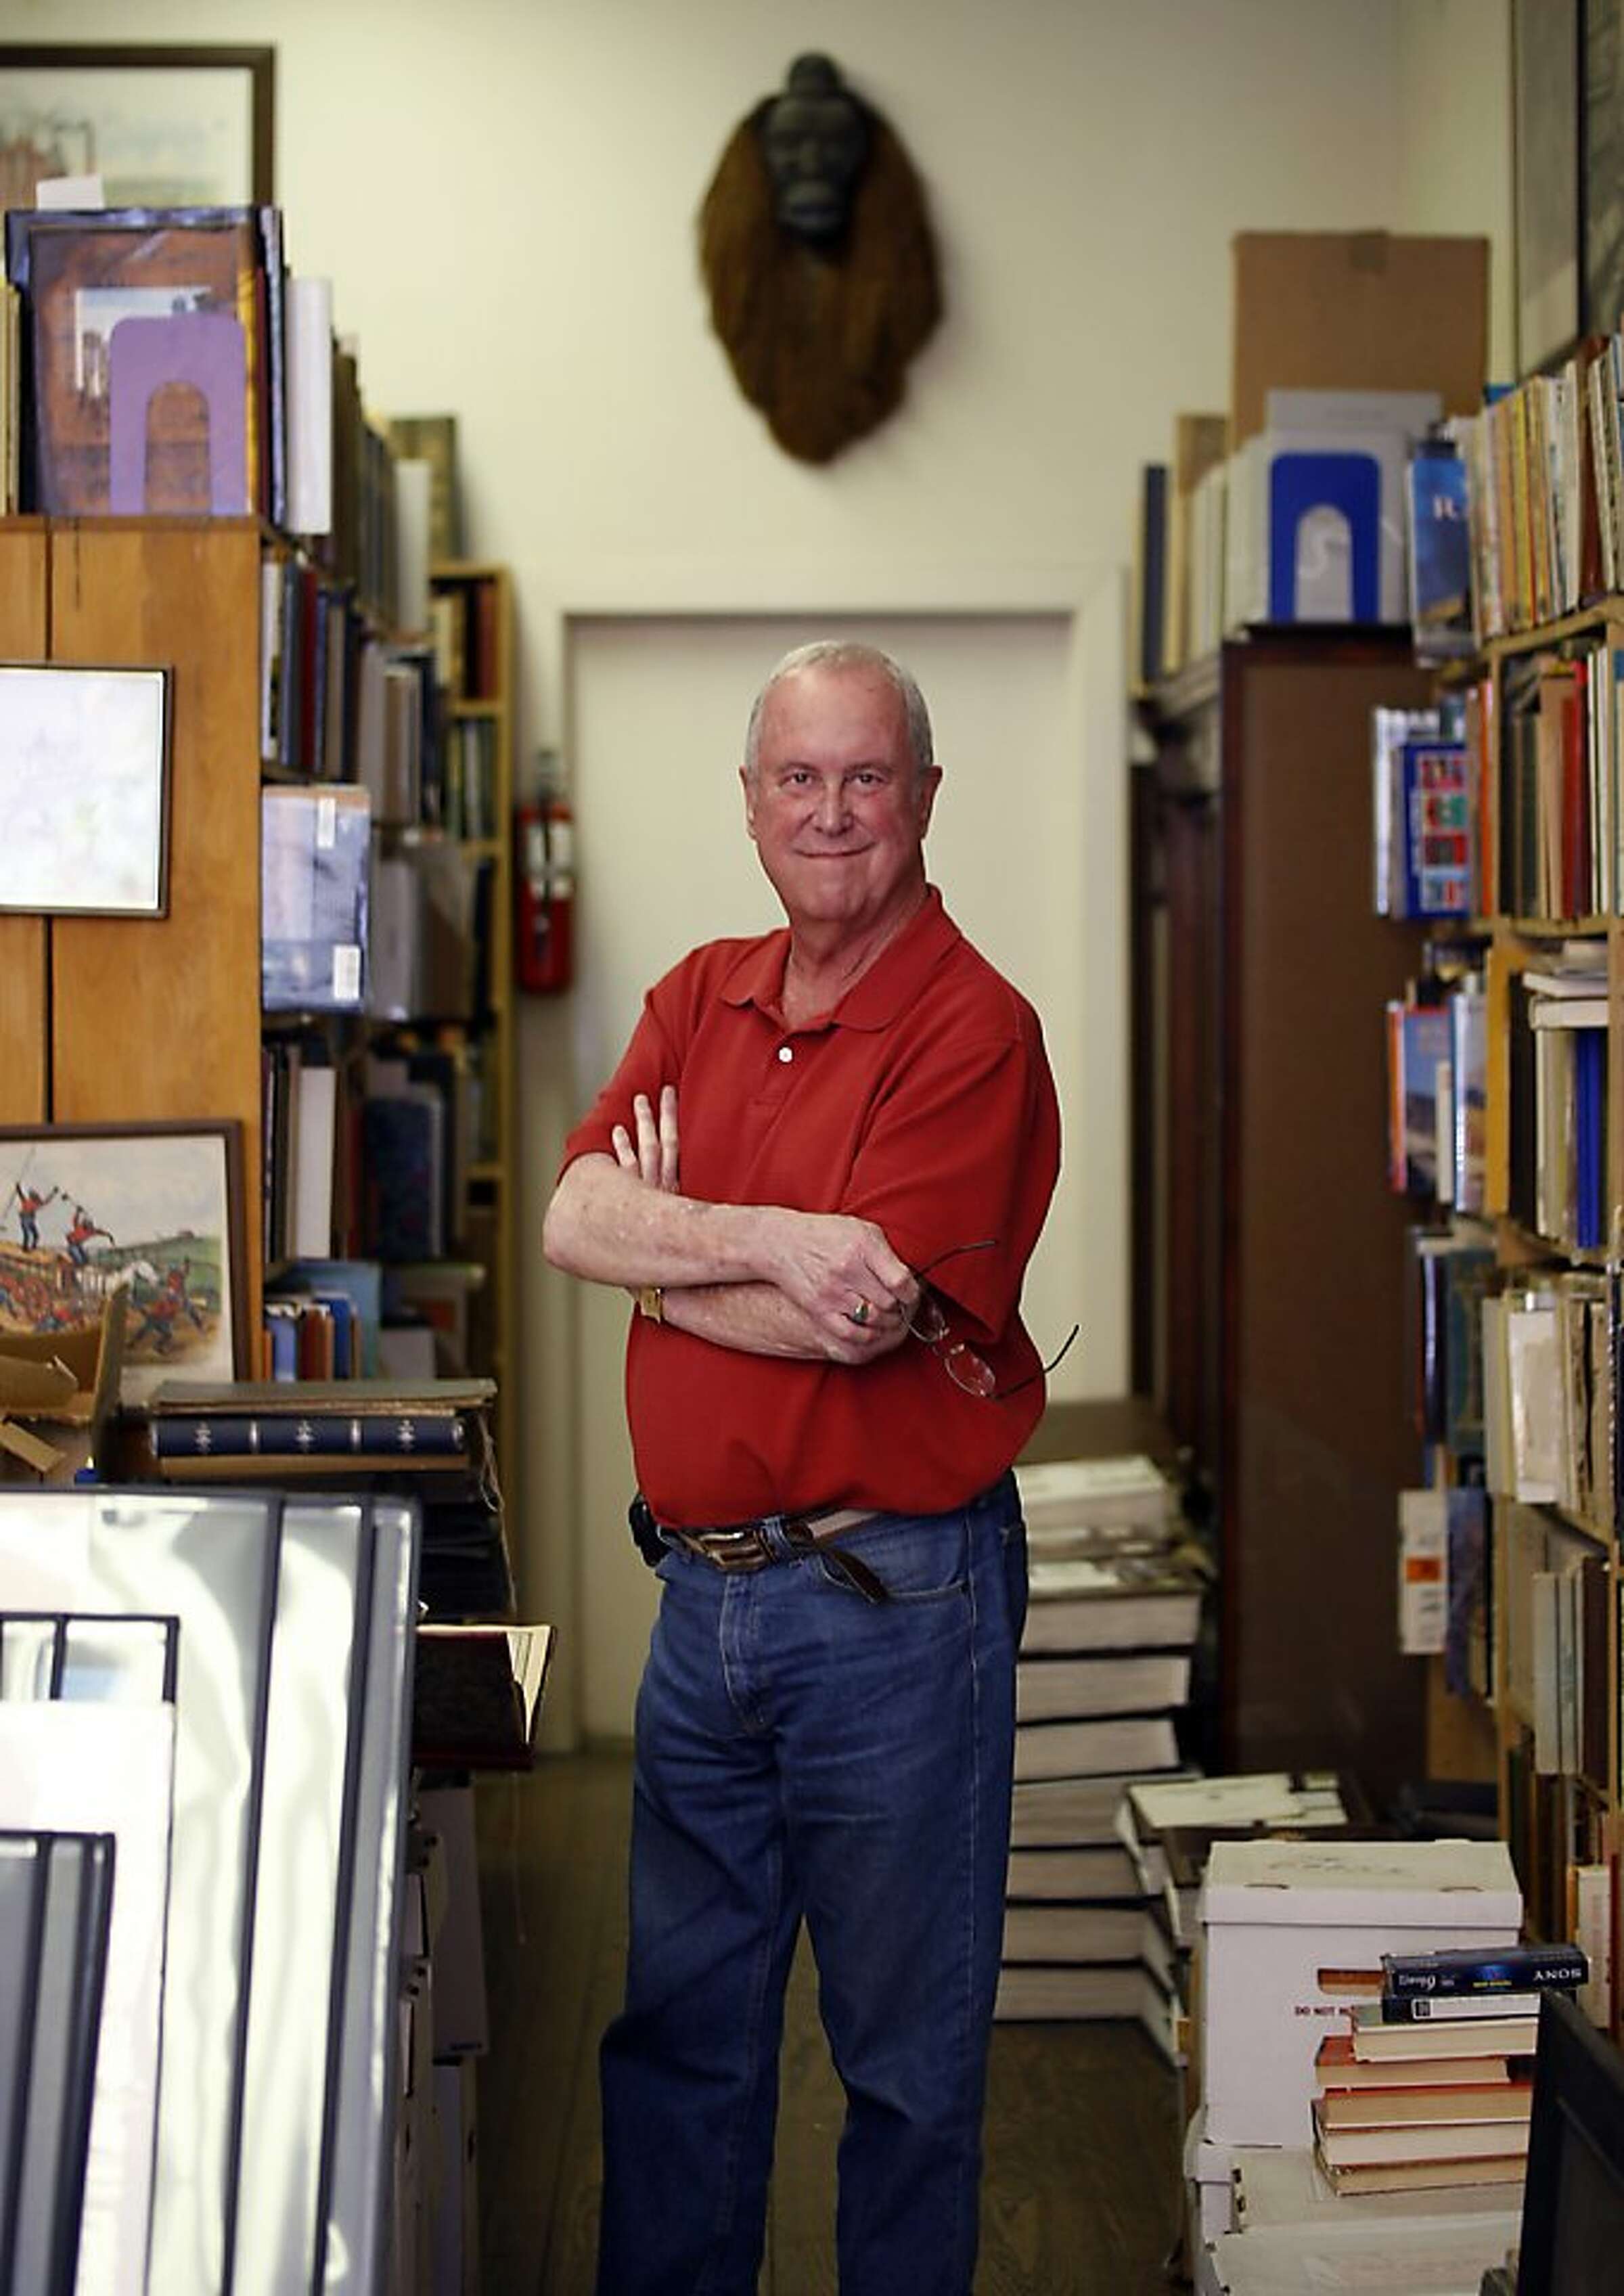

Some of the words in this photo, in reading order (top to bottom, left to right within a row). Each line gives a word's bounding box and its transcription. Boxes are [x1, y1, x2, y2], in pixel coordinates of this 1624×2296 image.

[1533, 1968, 1582, 1981] SONY
[1294, 2006, 1311, 2016] DO
[1313, 2006, 1335, 2016] NOT
